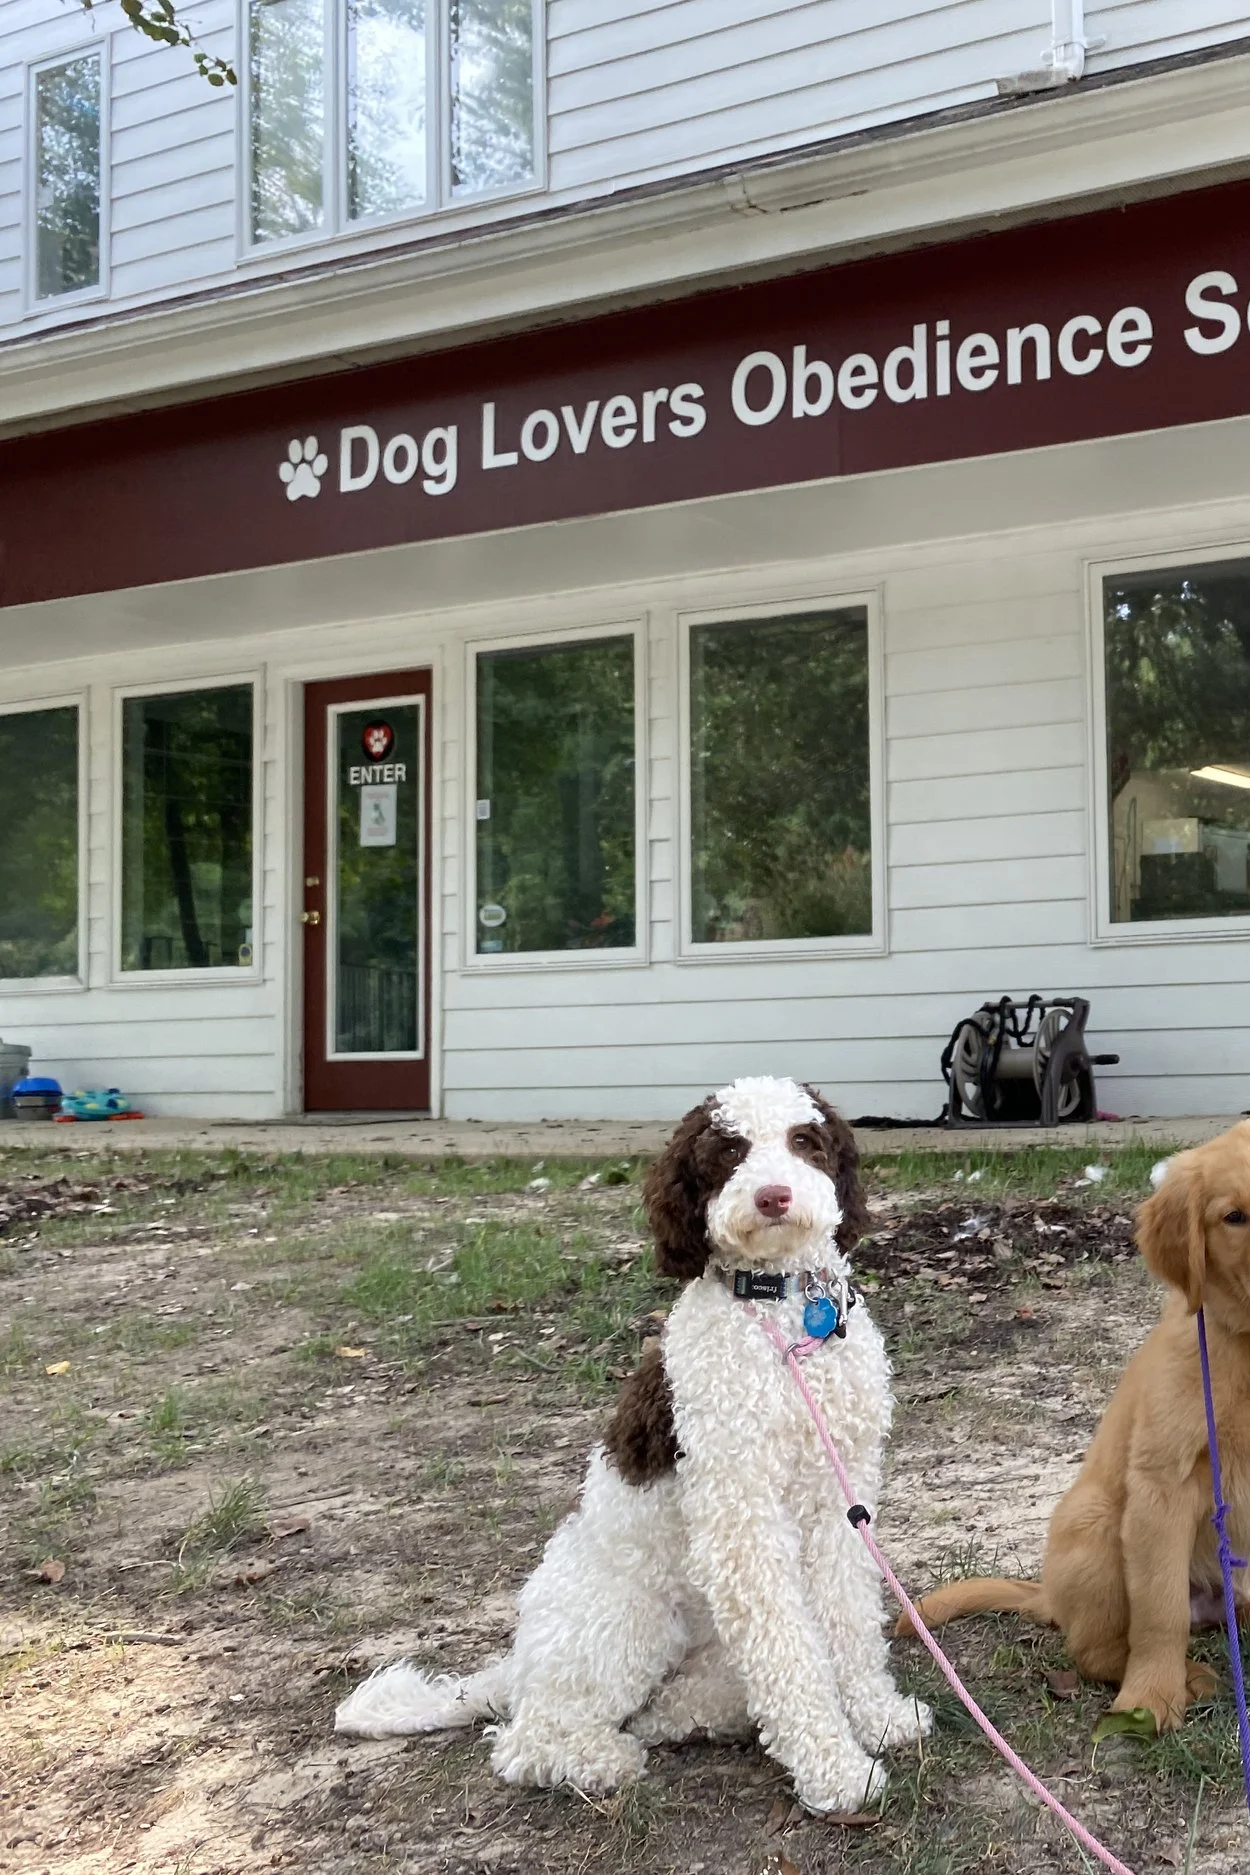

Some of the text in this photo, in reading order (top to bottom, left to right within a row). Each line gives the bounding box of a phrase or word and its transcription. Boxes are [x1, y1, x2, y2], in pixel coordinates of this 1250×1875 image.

[340, 425, 458, 502] Dog
[482, 383, 707, 470] Lovers
[731, 307, 1153, 426] Obedience
[349, 763, 407, 785] ENTER
